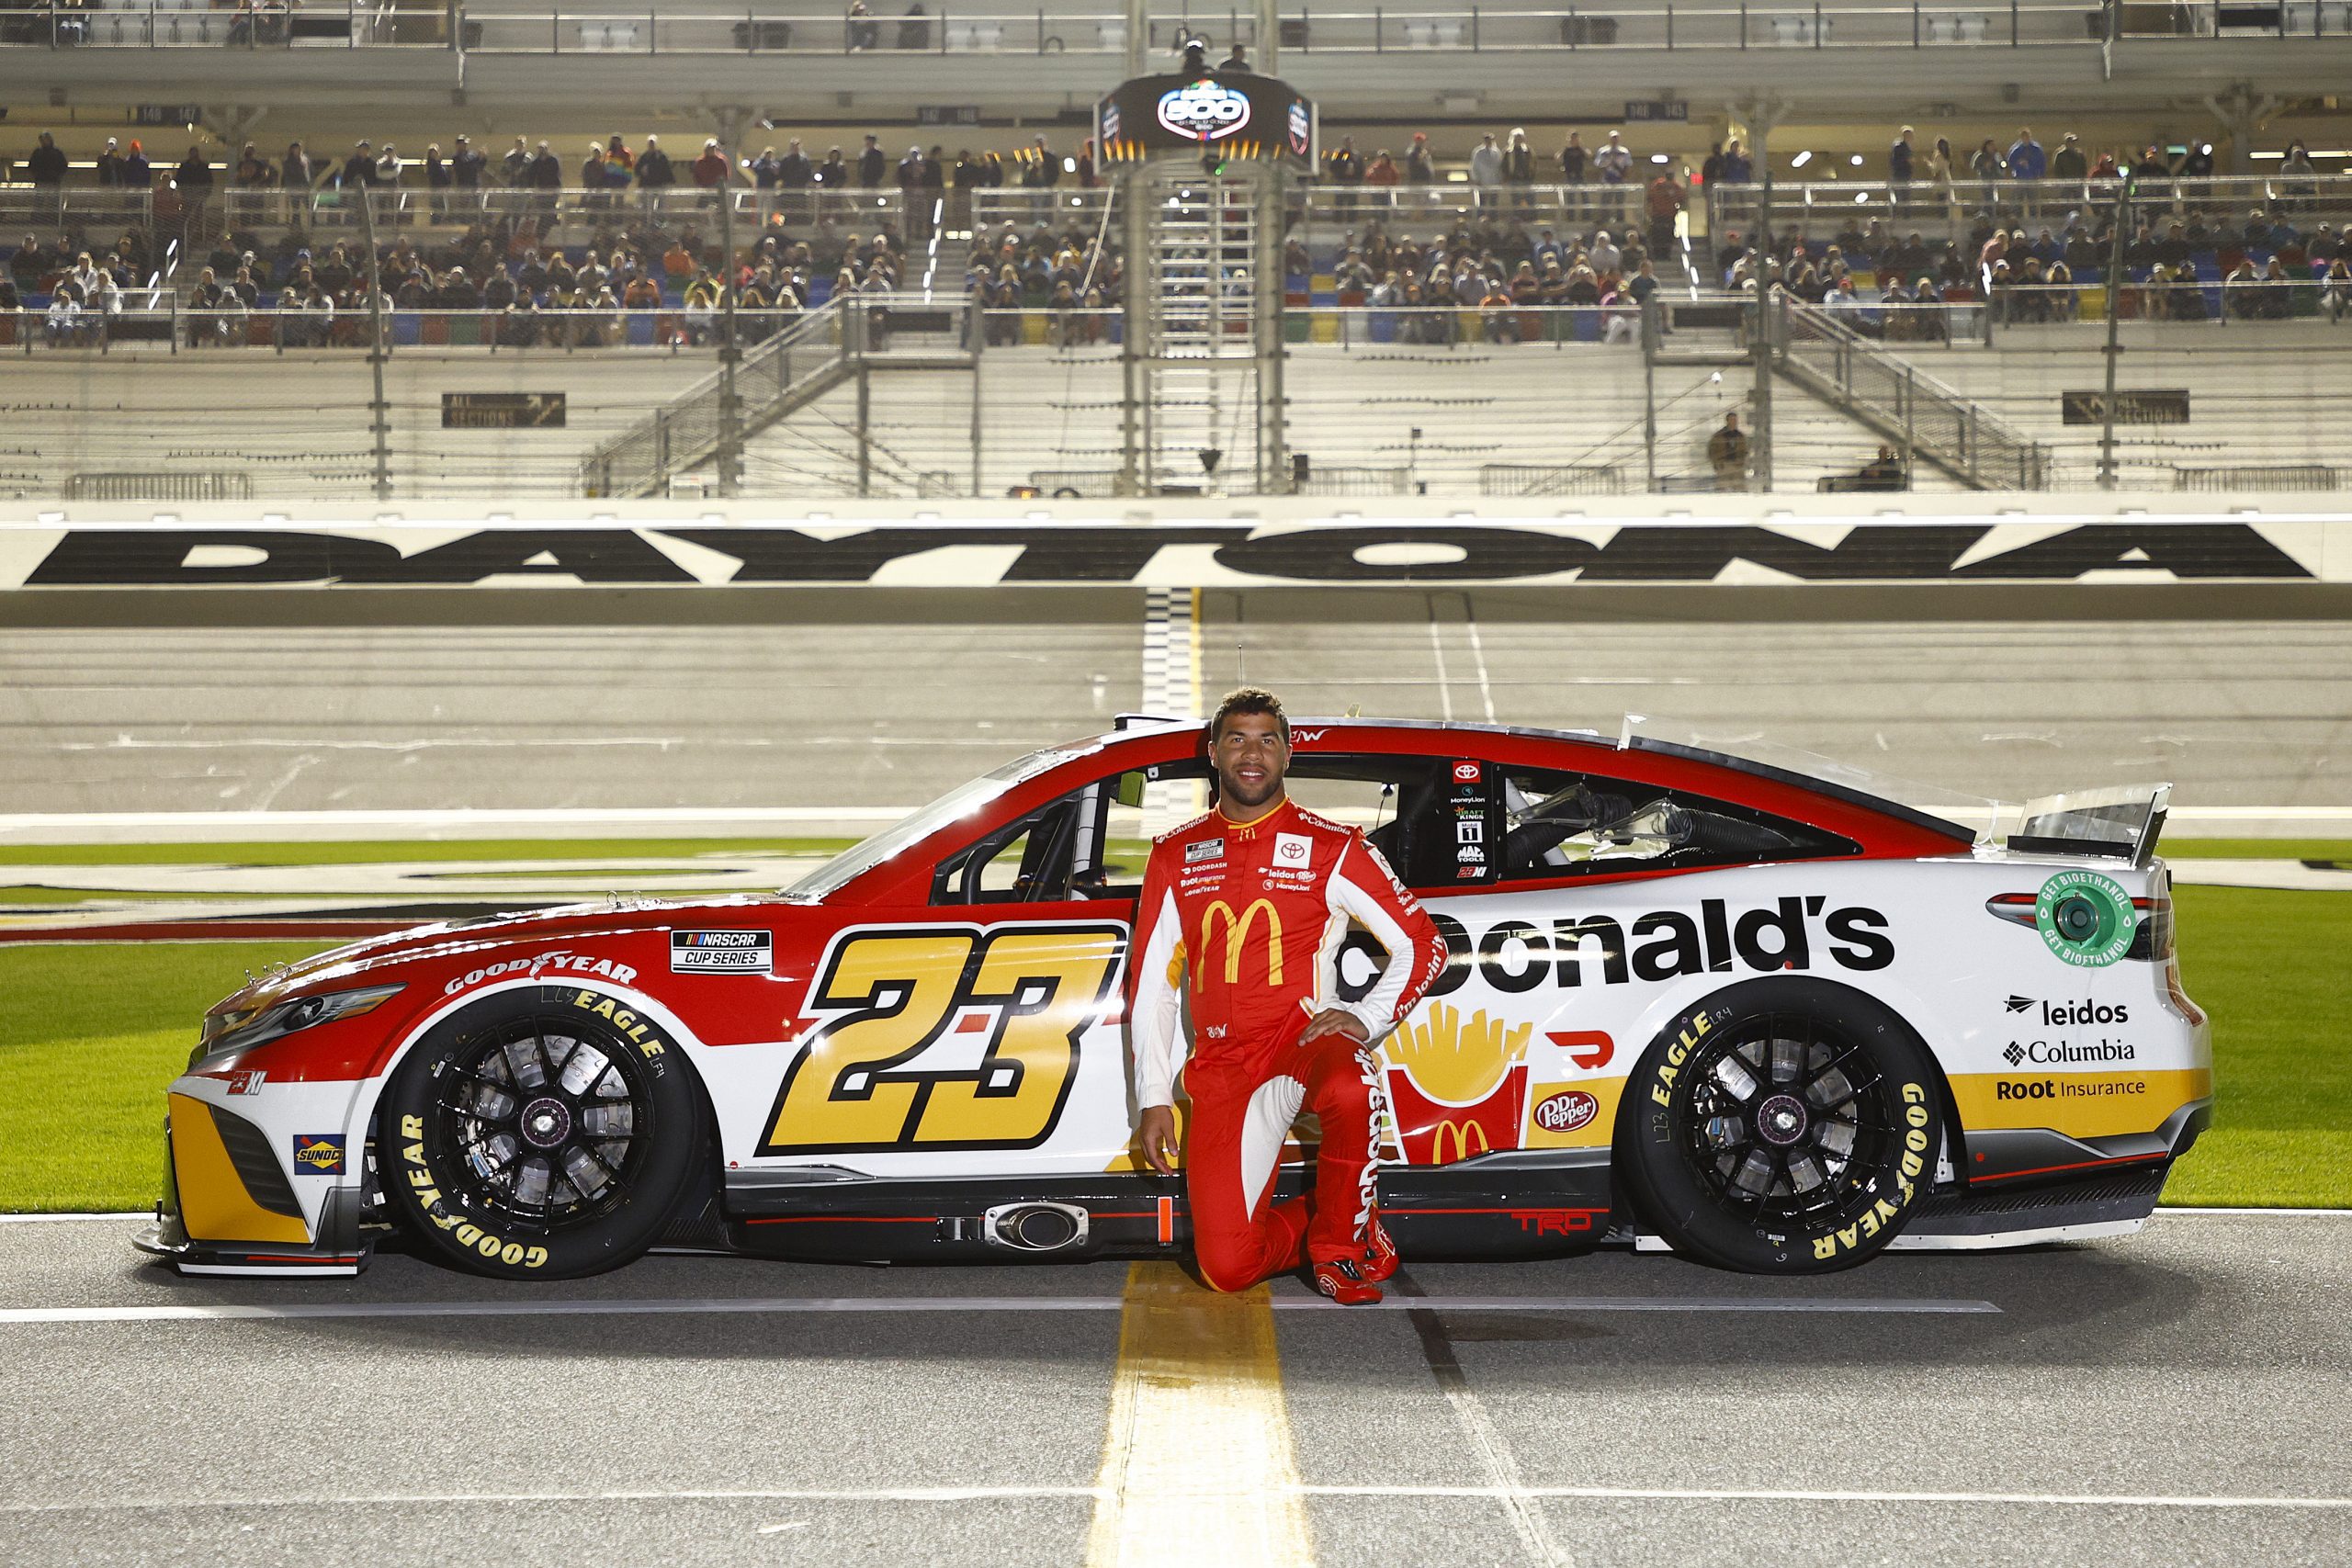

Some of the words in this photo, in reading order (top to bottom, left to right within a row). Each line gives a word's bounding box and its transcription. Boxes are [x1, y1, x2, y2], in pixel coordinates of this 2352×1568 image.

[1165, 99, 1243, 121] 500
[22, 525, 2320, 585] DAYTONA
[1450, 796, 1486, 805] MoneyLion
[1306, 816, 1352, 837] Columbia
[1465, 828, 1474, 840] 1
[1457, 845, 1485, 858] MAC
[1192, 862, 1227, 873] DOORDASH
[1268, 868, 1295, 880] leidos
[1276, 882, 1311, 892] MoneyLion
[2041, 880, 2060, 901] GET
[2058, 872, 2130, 911] BIOETHANOL
[703, 933, 757, 946] NASCAR
[2044, 929, 2064, 951] GET
[684, 952, 711, 964] CUP
[713, 952, 758, 964] SERIES
[1396, 996, 1418, 1019] i'm
[2042, 998, 2129, 1026] leidos
[572, 989, 666, 1059] EAGLE
[753, 925, 1128, 1158] 23
[2028, 1039, 2135, 1064] Columbia
[1651, 1010, 1713, 1108] EAGLE
[1996, 1079, 2055, 1100] Root
[2061, 1081, 2145, 1098] Insurance
[1544, 1100, 1591, 1128] Pepper
[1556, 1096, 1578, 1112] Dr
[1511, 1213, 1592, 1236] TRD
